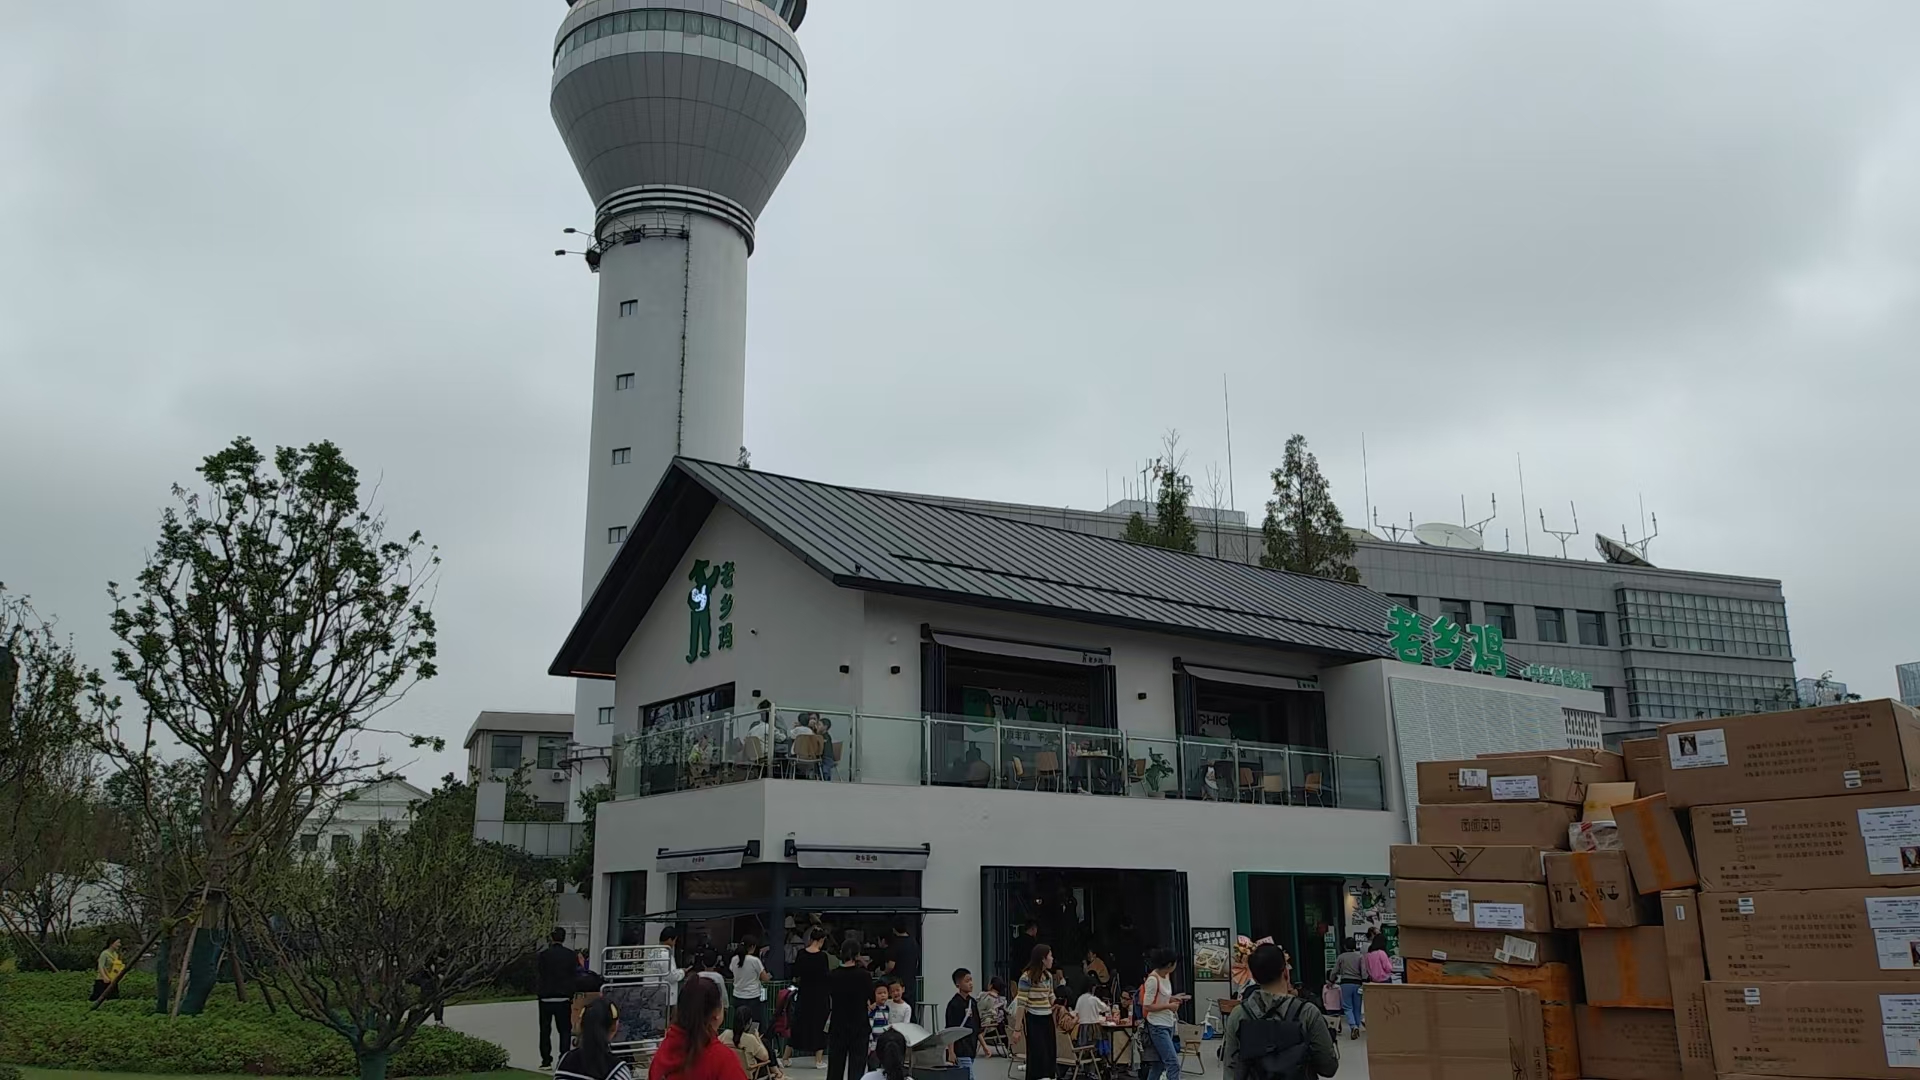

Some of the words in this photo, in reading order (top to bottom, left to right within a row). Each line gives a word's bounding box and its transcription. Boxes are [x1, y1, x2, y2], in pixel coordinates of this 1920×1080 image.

[718, 561, 736, 650] 老乡鸡
[1386, 604, 1507, 677] 老乡鸡
